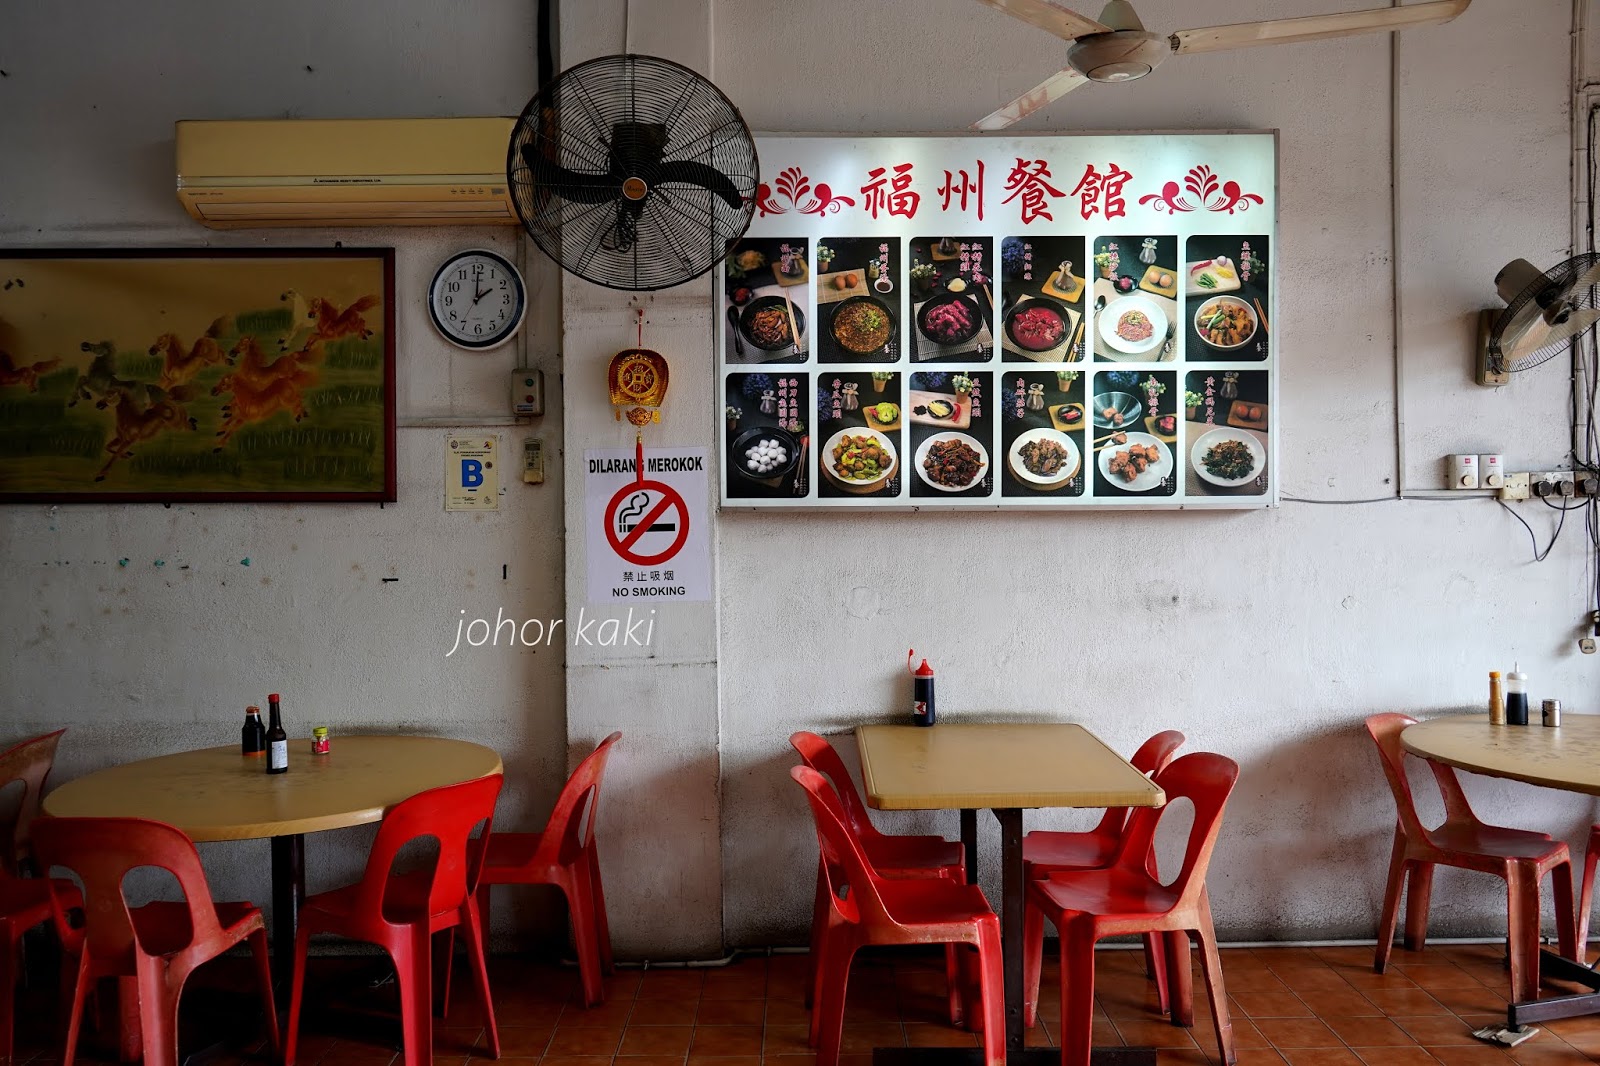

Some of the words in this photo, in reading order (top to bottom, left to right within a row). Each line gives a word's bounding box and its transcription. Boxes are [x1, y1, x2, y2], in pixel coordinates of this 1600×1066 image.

[860, 157, 1133, 225] 福州餐館
[458, 270, 467, 280] 11
[472, 264, 484, 275] 12
[490, 269, 495, 279] 1
[448, 282, 460, 292] 10
[499, 280, 507, 290] 2
[445, 296, 453, 306] 9
[502, 294, 510, 305] 3
[449, 310, 457, 321] 8
[498, 309, 505, 320] 4
[460, 320, 467, 331] 7
[474, 324, 482, 334] 6
[489, 320, 496, 330] 5
[589, 459, 644, 473] DILARAN
[648, 456, 703, 472] MEROKOK
[461, 459, 484, 488] B
[623, 570, 674, 582] 禁止吸烟
[612, 587, 629, 597] NO
[632, 586, 686, 597] SMOKING
